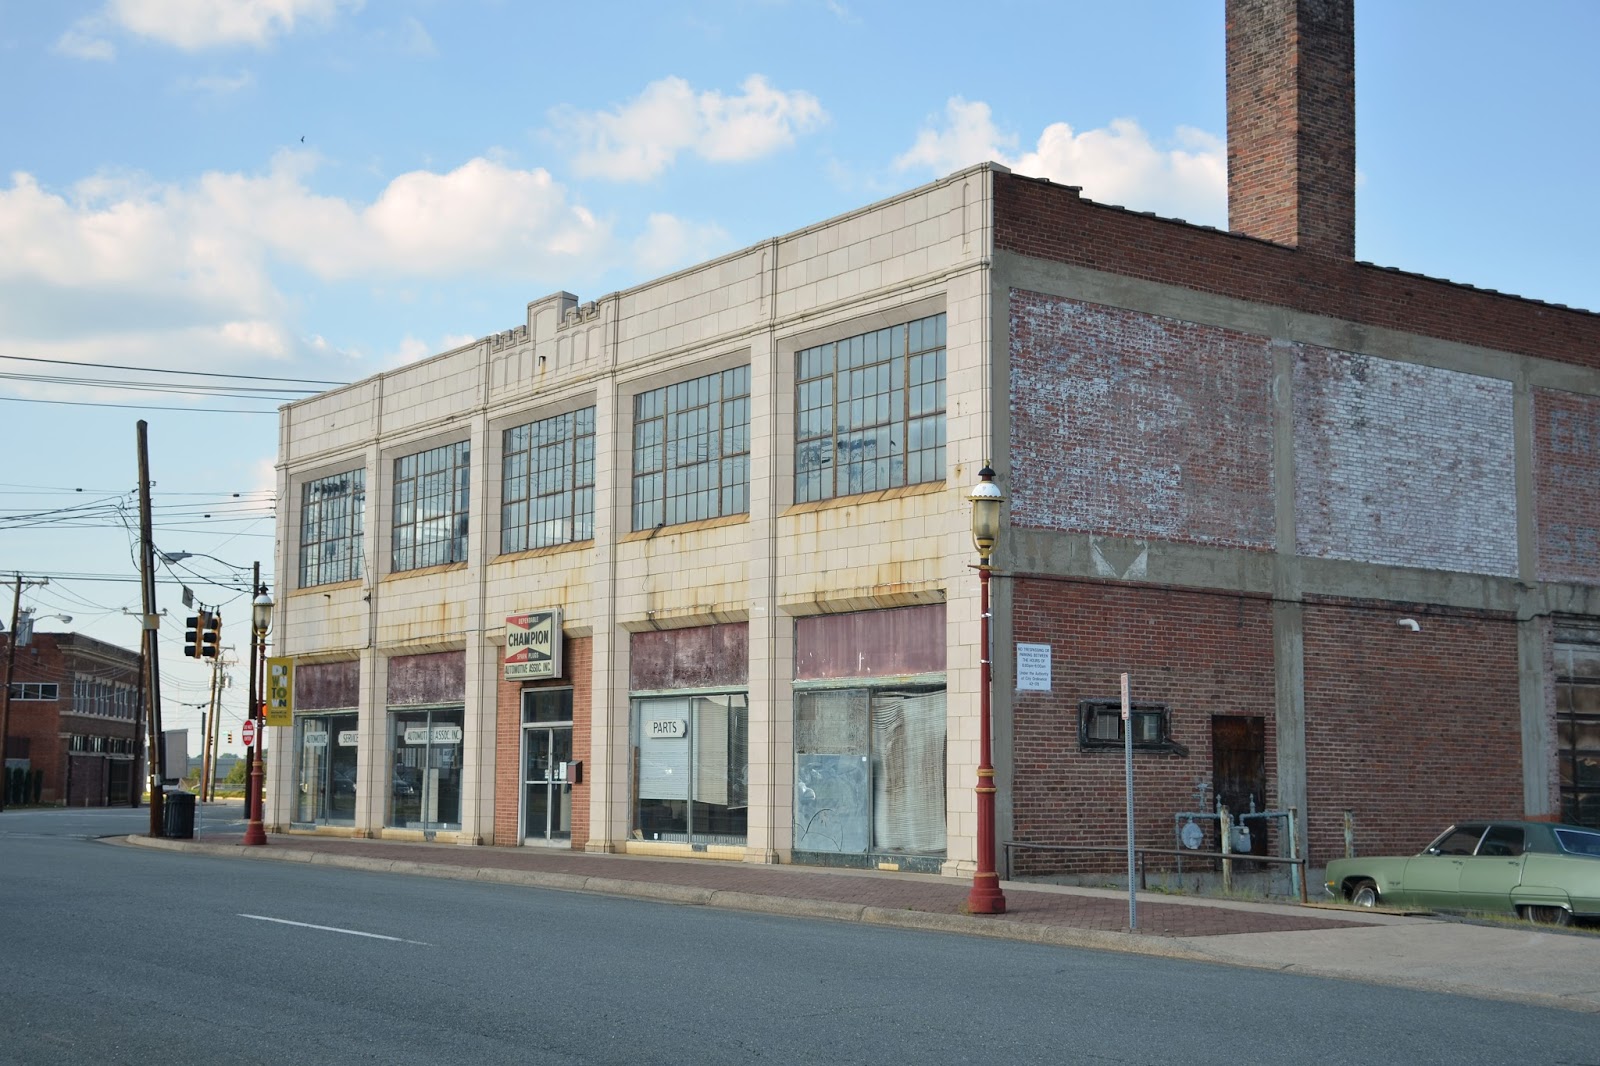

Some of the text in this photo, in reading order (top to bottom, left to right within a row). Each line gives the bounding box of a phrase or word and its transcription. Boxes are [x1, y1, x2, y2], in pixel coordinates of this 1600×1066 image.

[518, 616, 539, 624] DEPENDABLE
[508, 630, 549, 647] CHAMPION
[505, 664, 528, 674] AUTOMOTIVE
[653, 721, 677, 733] PARTS
[407, 730, 433, 741] AUTOMOTIE
